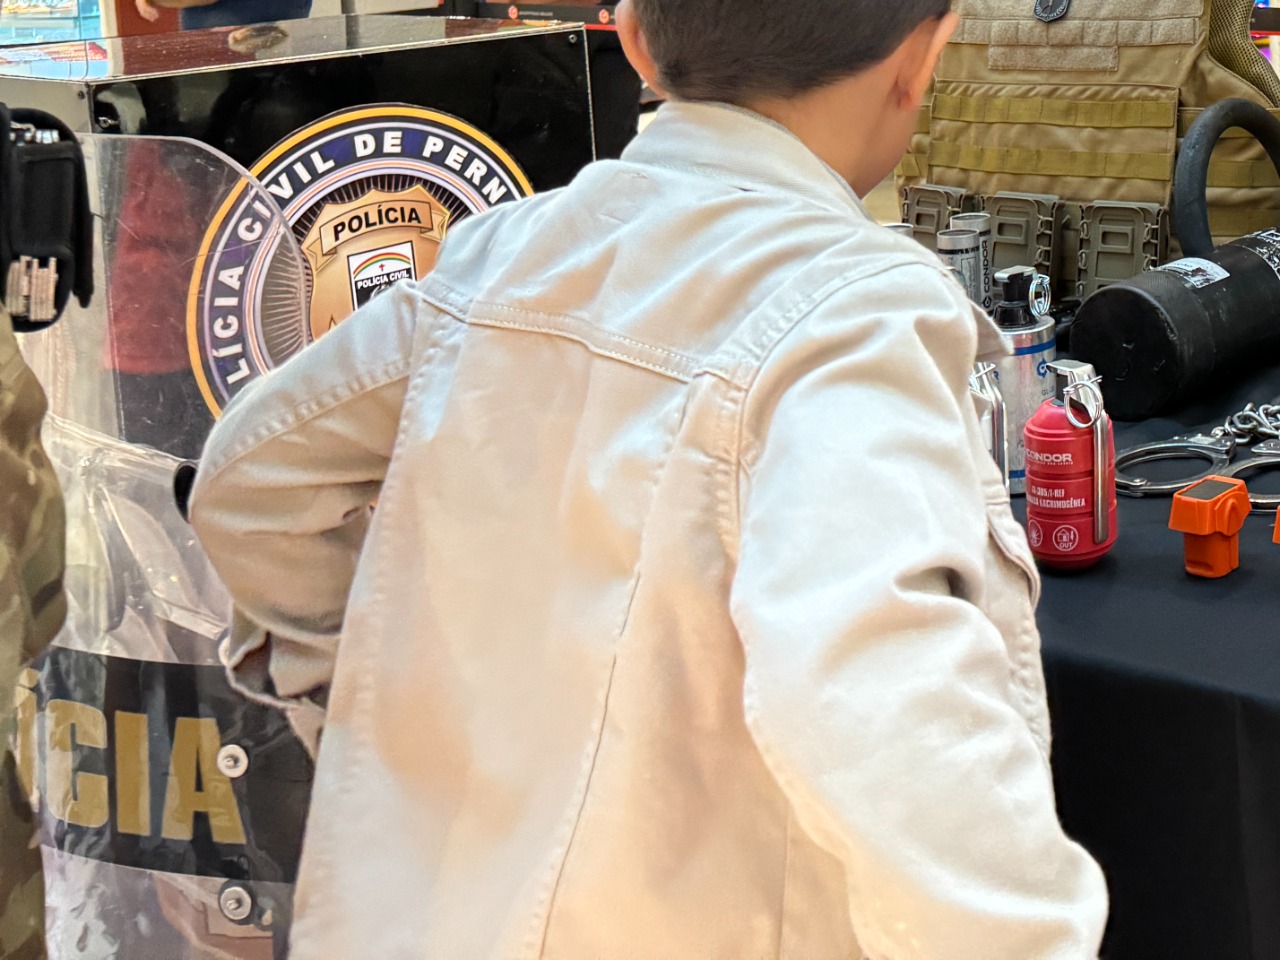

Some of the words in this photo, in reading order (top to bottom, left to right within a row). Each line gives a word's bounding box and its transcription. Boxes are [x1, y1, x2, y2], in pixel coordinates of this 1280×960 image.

[333, 205, 422, 242] POLÍCIA
[210, 264, 252, 386] LÍCIA
[236, 155, 336, 243] CIVIL
[354, 130, 404, 158] DE
[422, 136, 508, 205] PERN
[356, 274, 389, 289] POLÍCIA
[389, 269, 410, 280] CIVIL
[981, 240, 990, 293] CONDOR
[1026, 448, 1073, 462] CONDOR
[15, 668, 247, 844] ÍCIA
